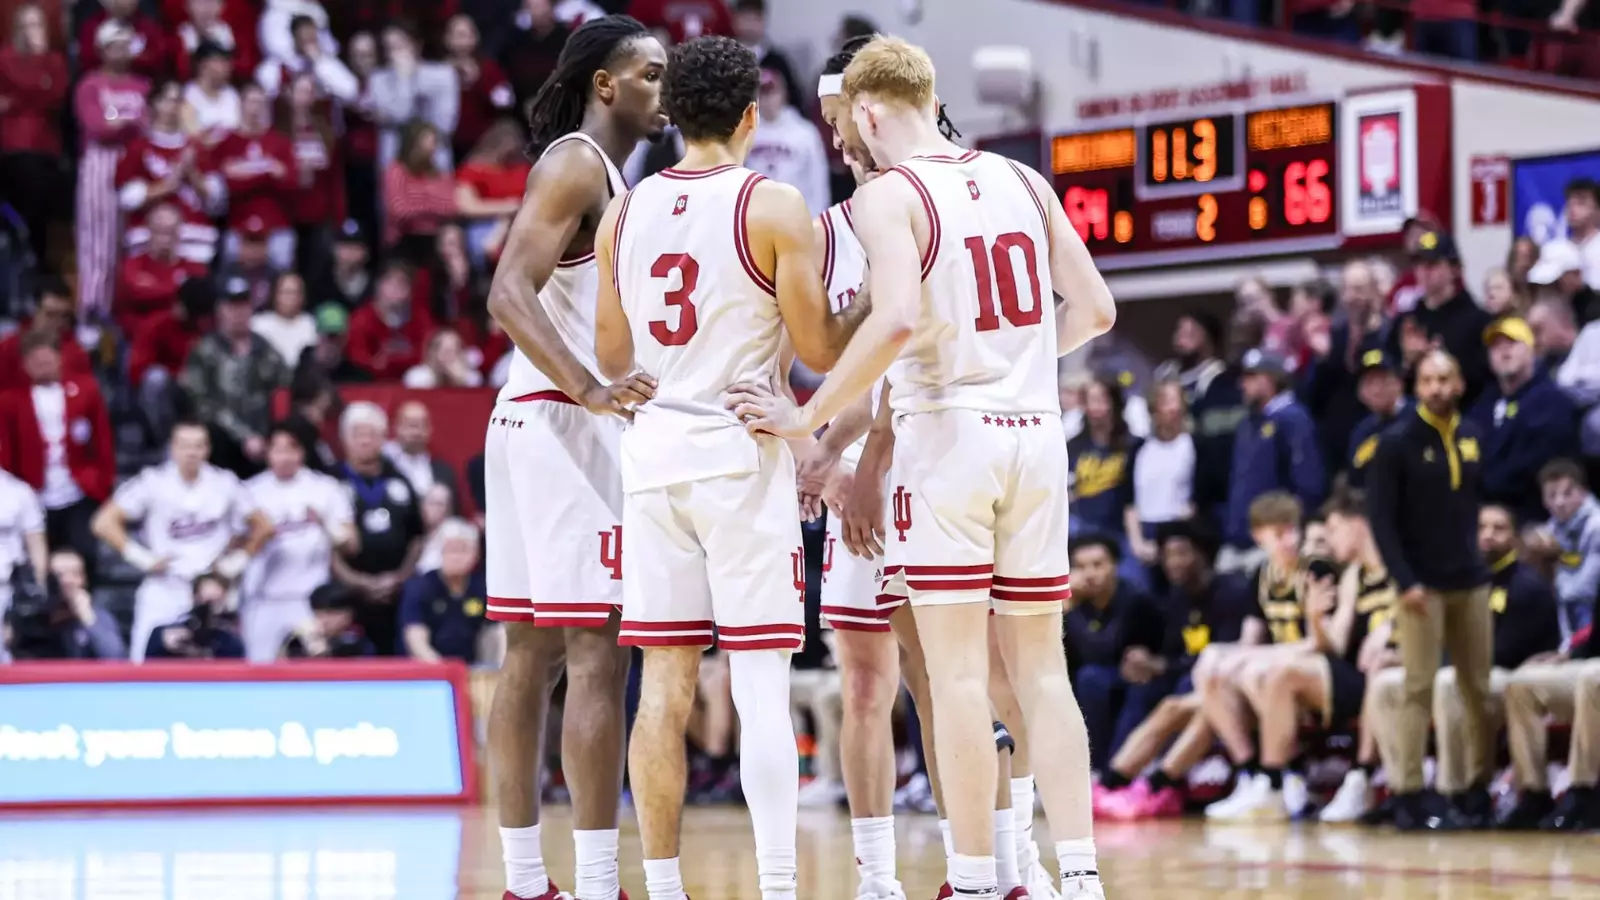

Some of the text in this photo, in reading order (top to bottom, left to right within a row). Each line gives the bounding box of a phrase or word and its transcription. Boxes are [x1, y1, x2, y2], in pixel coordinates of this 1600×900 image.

[1196, 193, 1218, 242] 2
[1284, 159, 1331, 225] 66
[649, 252, 699, 346] 3
[964, 231, 1042, 332] 10
